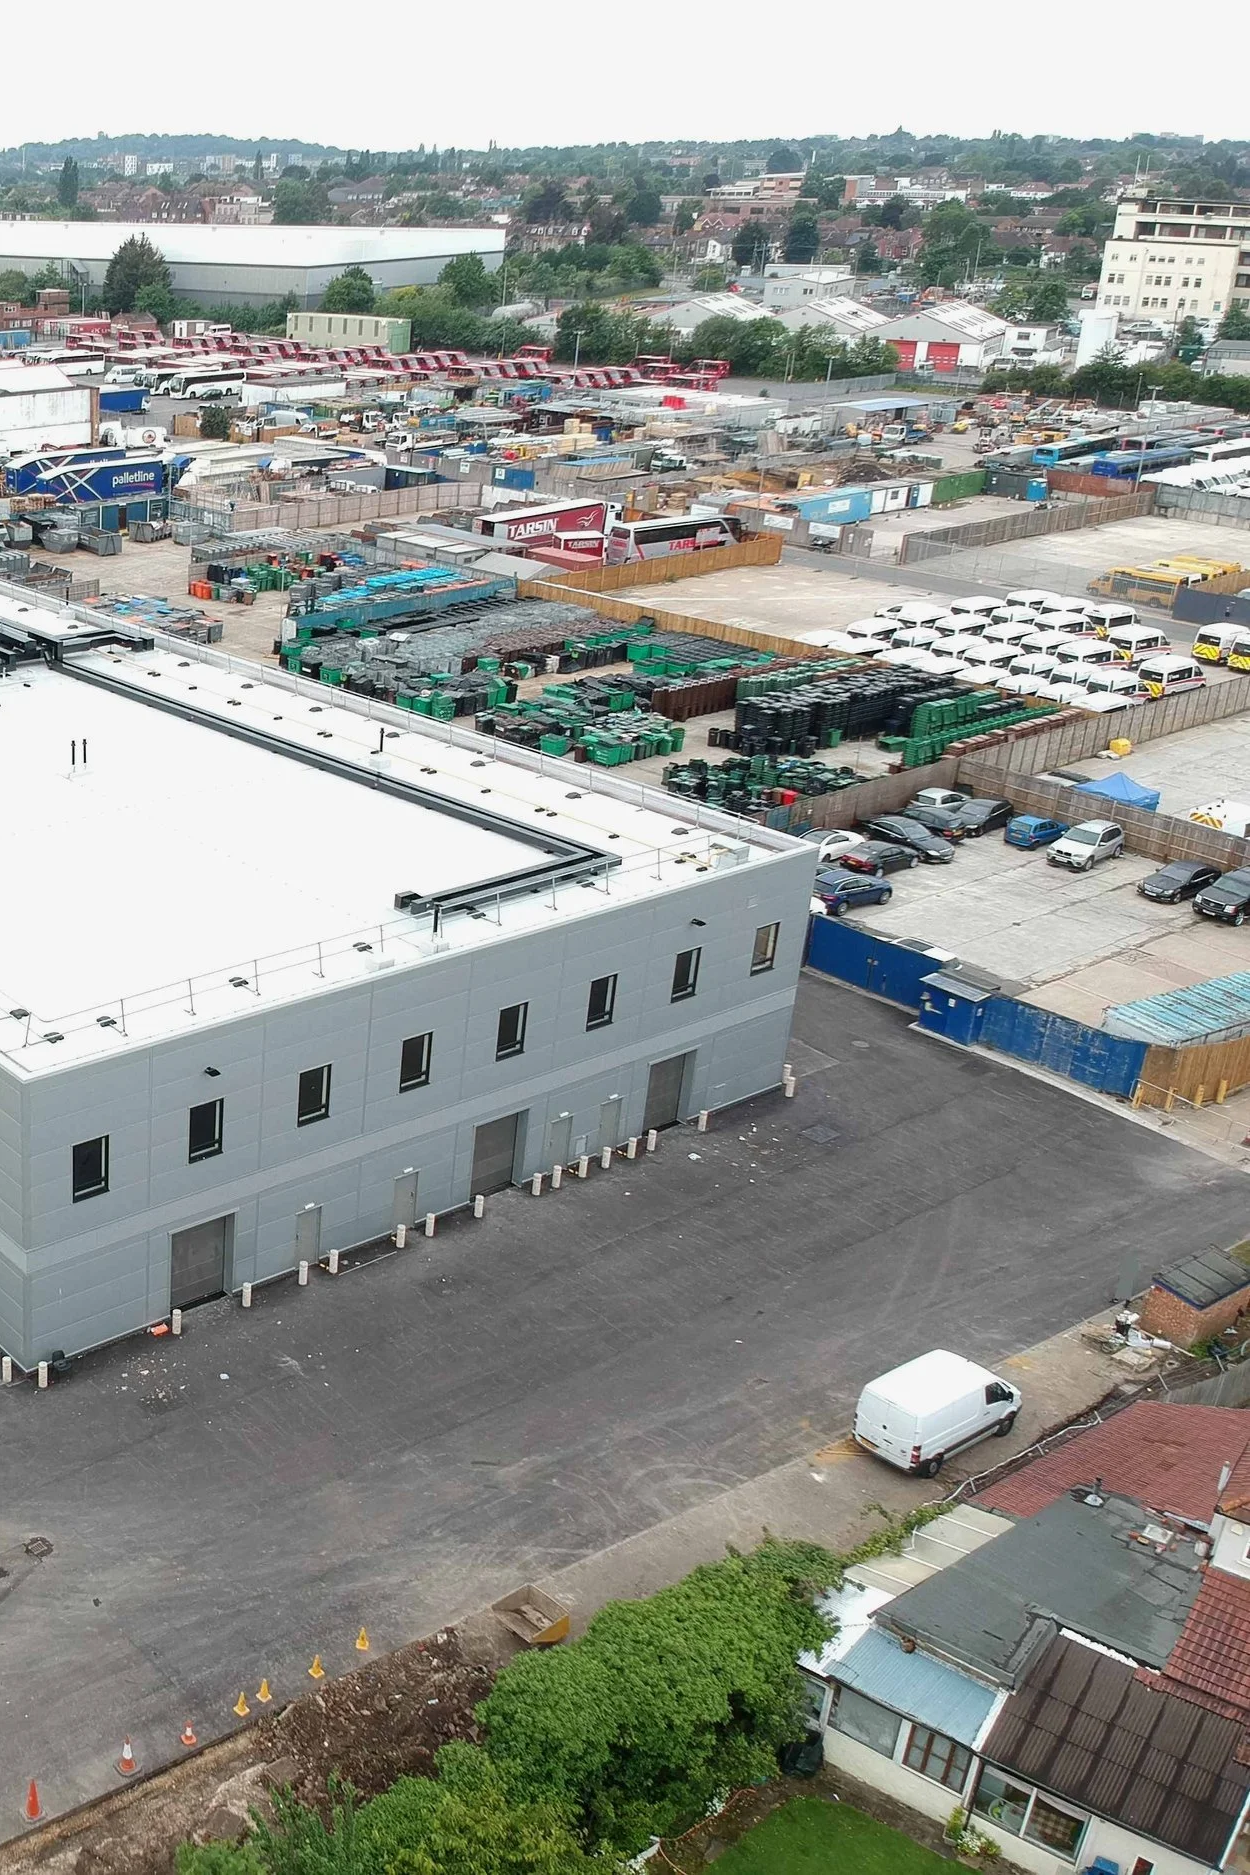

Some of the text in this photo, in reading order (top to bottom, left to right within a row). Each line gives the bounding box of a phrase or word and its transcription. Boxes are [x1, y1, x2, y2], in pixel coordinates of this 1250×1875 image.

[112, 471, 155, 487] palletline
[509, 518, 559, 539] TARSIN
[669, 537, 697, 551] TARS
